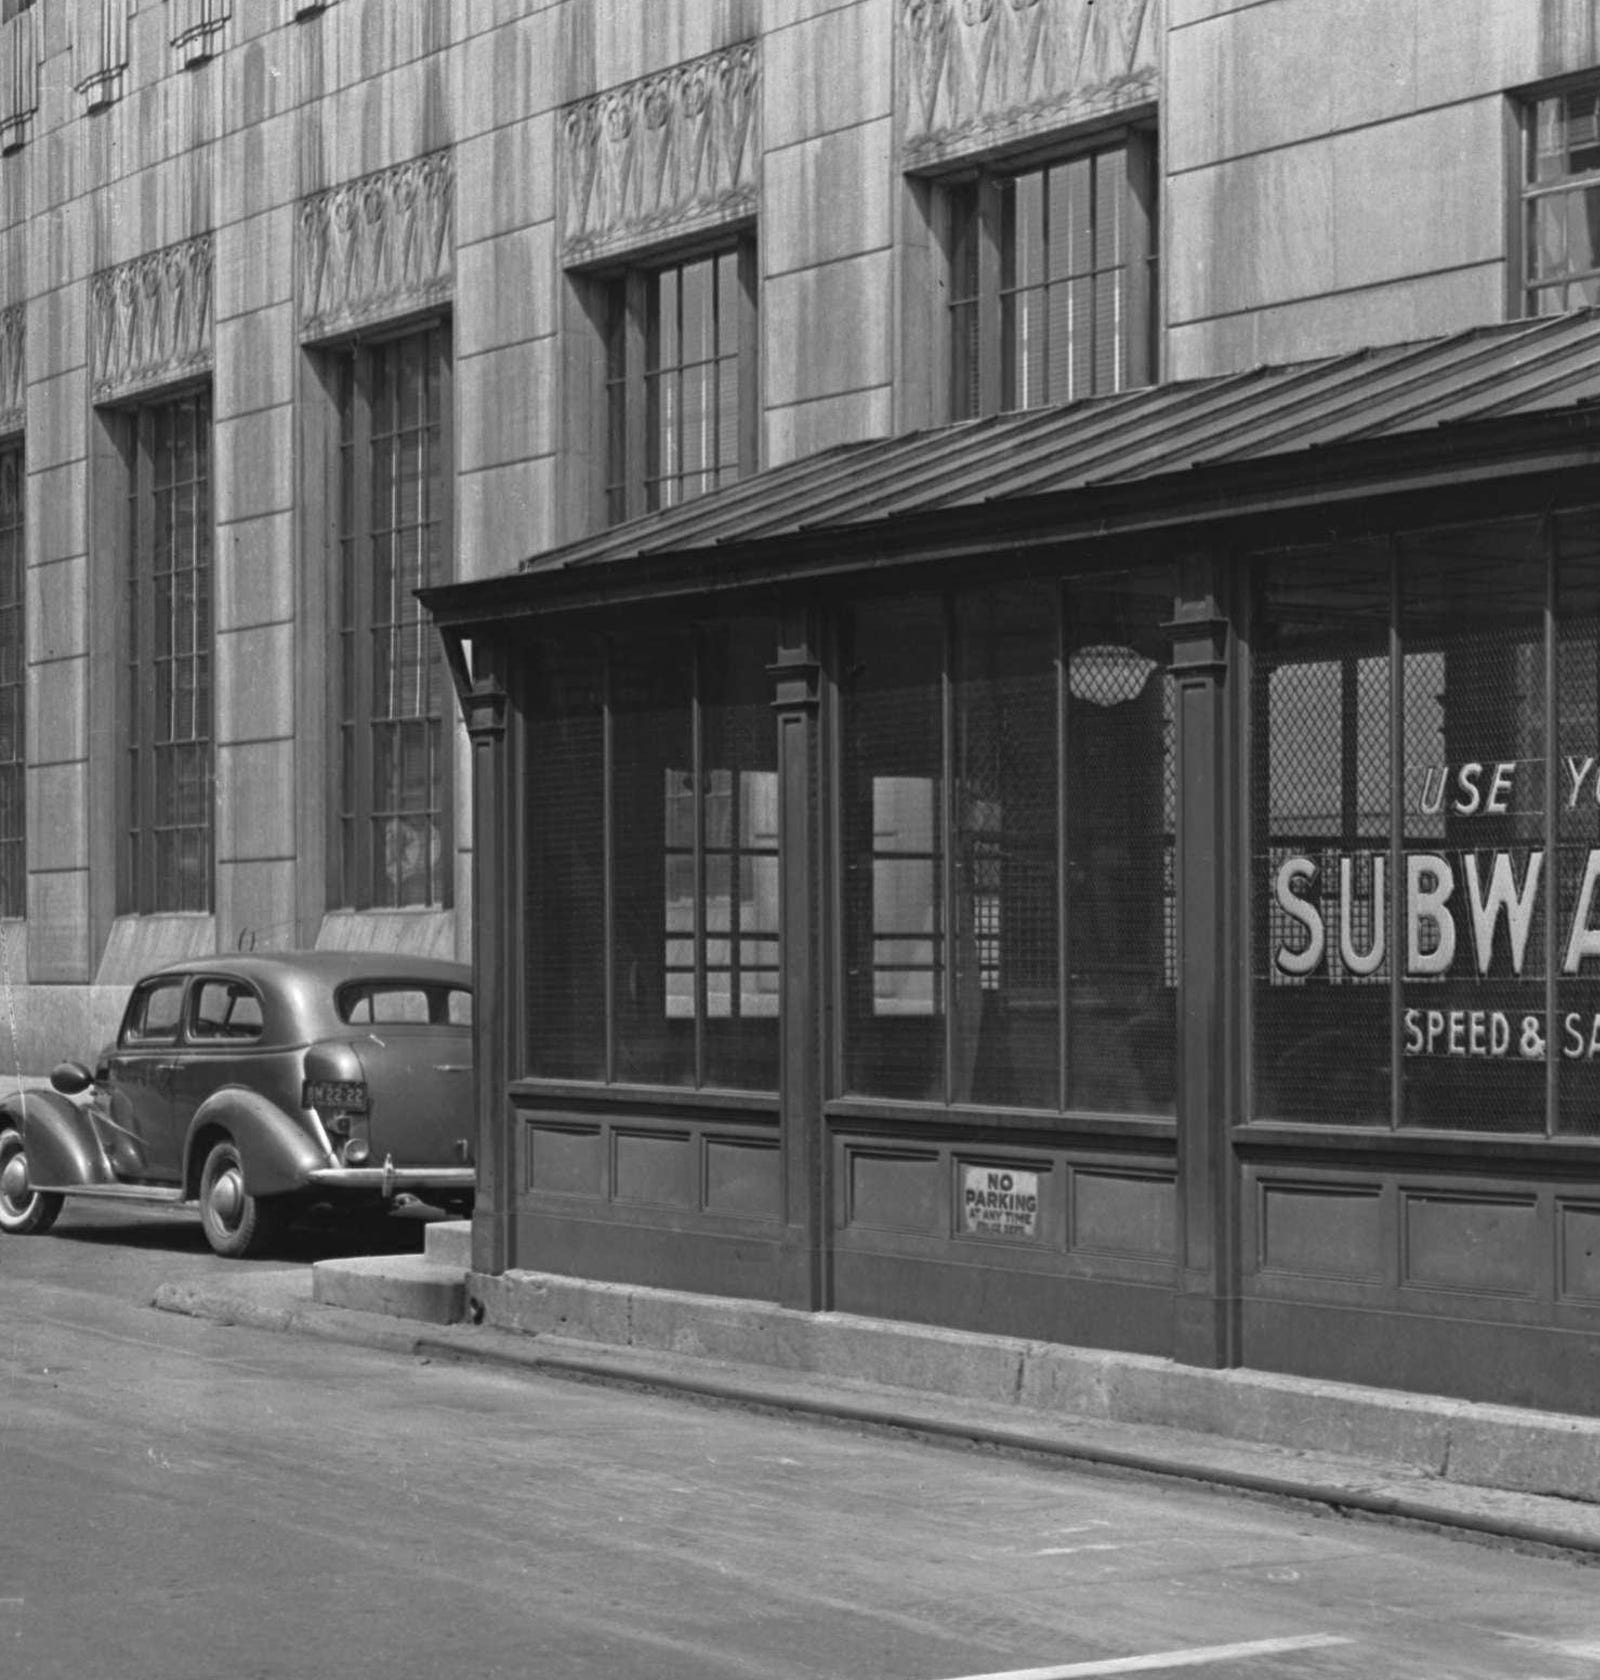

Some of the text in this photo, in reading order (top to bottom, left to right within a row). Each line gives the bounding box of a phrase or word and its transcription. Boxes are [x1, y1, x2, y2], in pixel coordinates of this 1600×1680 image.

[1419, 761, 1516, 815] USE
[1404, 1006, 1511, 1057] SPEED
[1520, 1015, 1547, 1057] &
[987, 1173, 1014, 1191] NO
[965, 1189, 1037, 1213] PARKING
[1005, 1211, 1033, 1225] TIME
